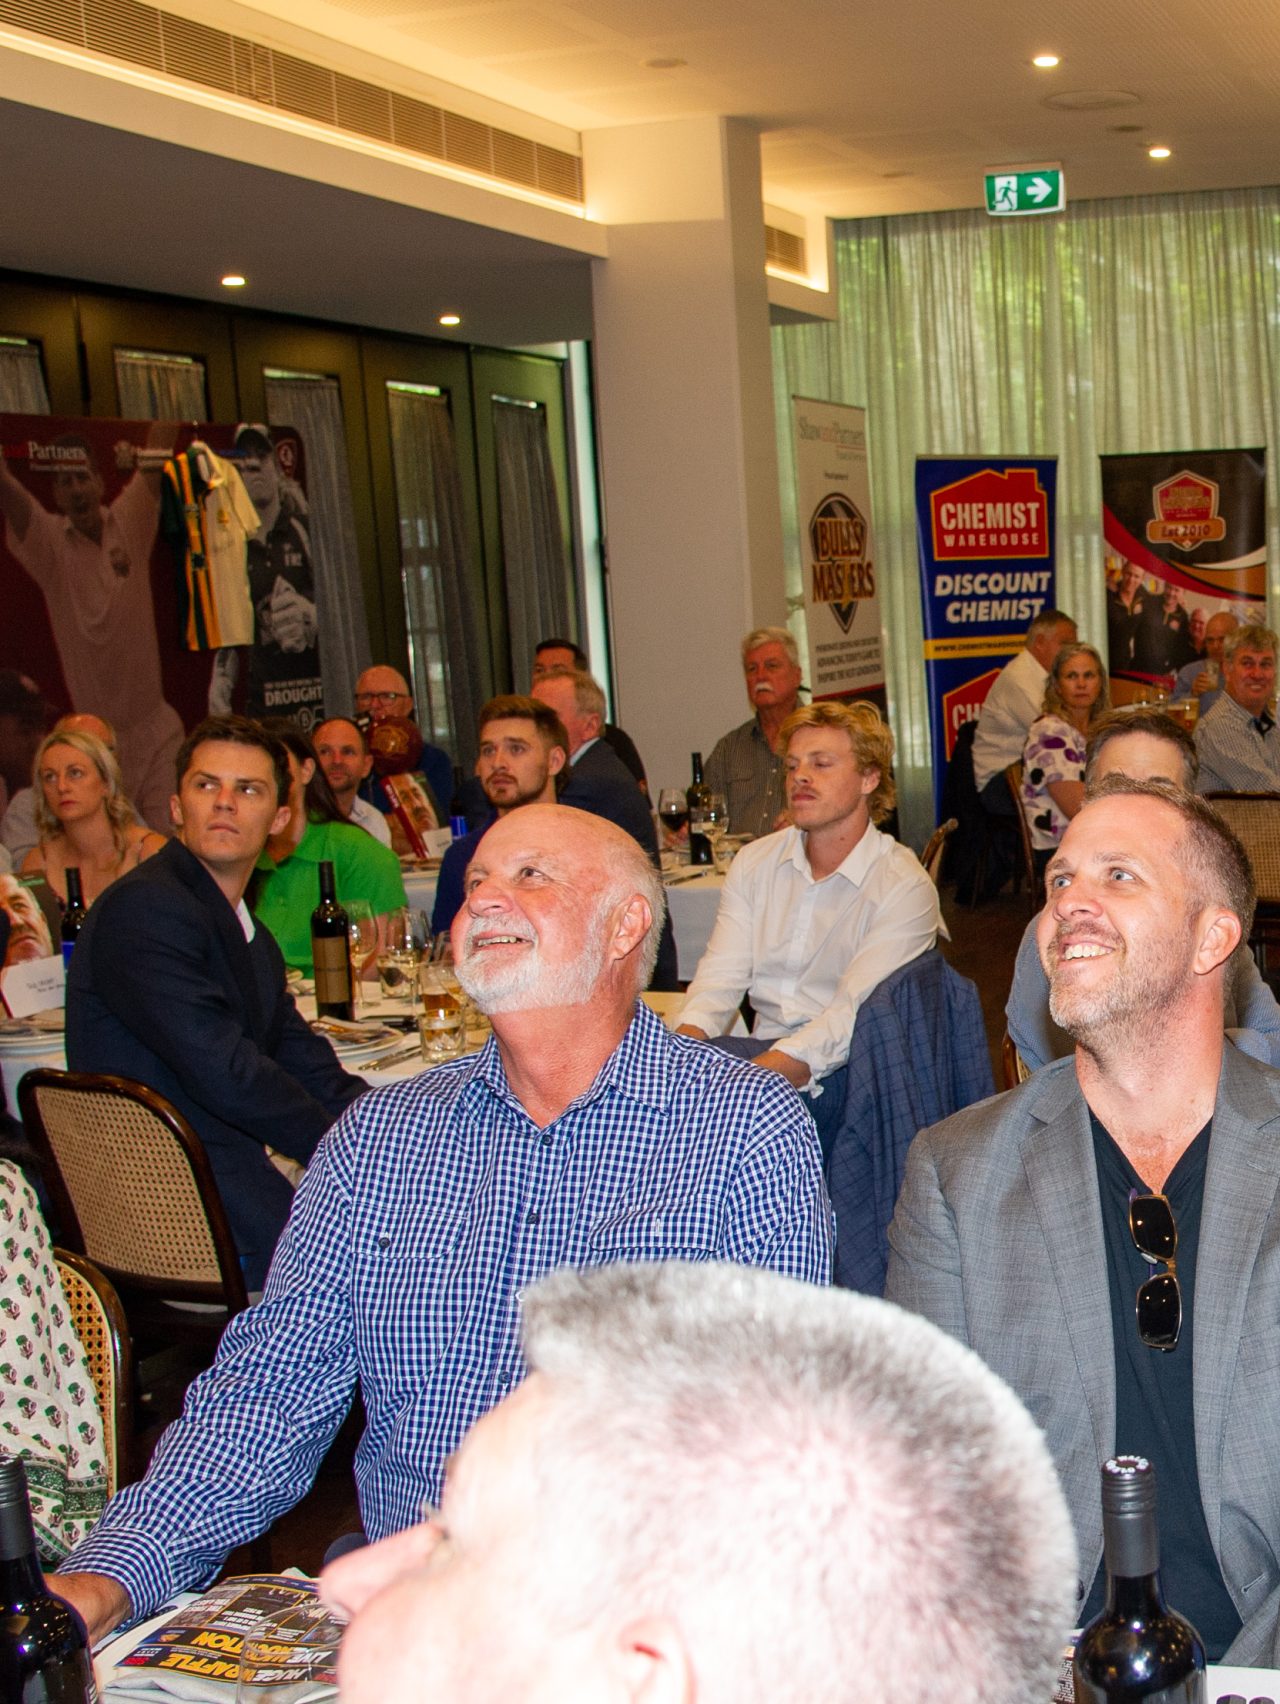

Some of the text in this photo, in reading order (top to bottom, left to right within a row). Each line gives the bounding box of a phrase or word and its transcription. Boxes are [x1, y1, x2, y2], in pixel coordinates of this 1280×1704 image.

[28, 440, 87, 460] Partners
[940, 502, 1040, 530] CHEMIST
[815, 518, 864, 558] BULLS
[943, 533, 1040, 548] WAREHOUSE
[812, 560, 876, 603] MASTERS
[934, 571, 1051, 597] DISCOUNT
[945, 598, 1045, 624] CHEMIST
[264, 686, 324, 707] DROUGHT
[250, 1666, 308, 1683] HUGE
